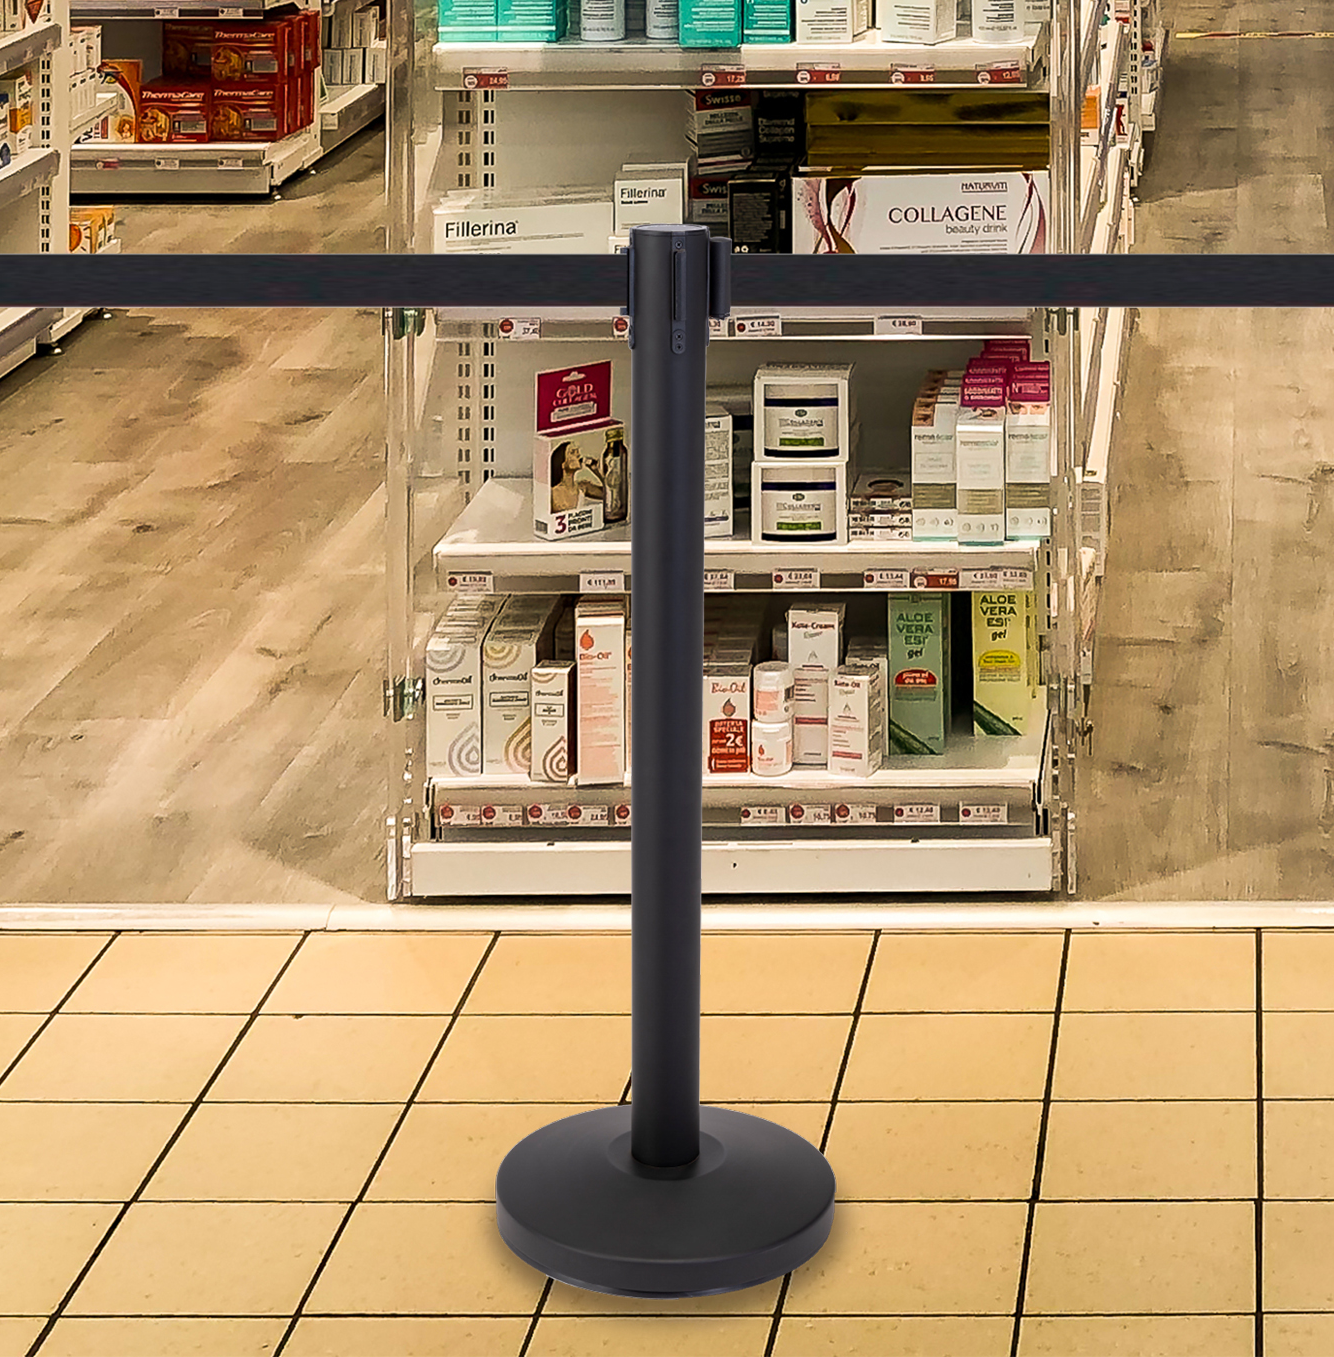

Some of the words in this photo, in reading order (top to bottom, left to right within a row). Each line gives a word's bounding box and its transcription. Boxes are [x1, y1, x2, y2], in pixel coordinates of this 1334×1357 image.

[142, 91, 205, 100] ThermaCare
[705, 94, 742, 105] Swisse
[620, 187, 665, 199] Fillerina
[888, 205, 1008, 224] COLLAGENE
[444, 219, 517, 239] Fillerina
[945, 225, 980, 236] beauty
[982, 223, 1008, 234] drink
[555, 383, 594, 399] GOLD
[555, 515, 567, 534] 3
[979, 594, 1017, 605] ALOE
[896, 612, 933, 623] ALOE
[979, 606, 1017, 617] VERA
[896, 623, 933, 634] VERA
[991, 630, 1007, 642] gel
[579, 652, 612, 661] Bio-Oil
[907, 647, 923, 660] gel
[711, 682, 747, 695] Bio-Oil
[725, 733, 744, 747] 2€
